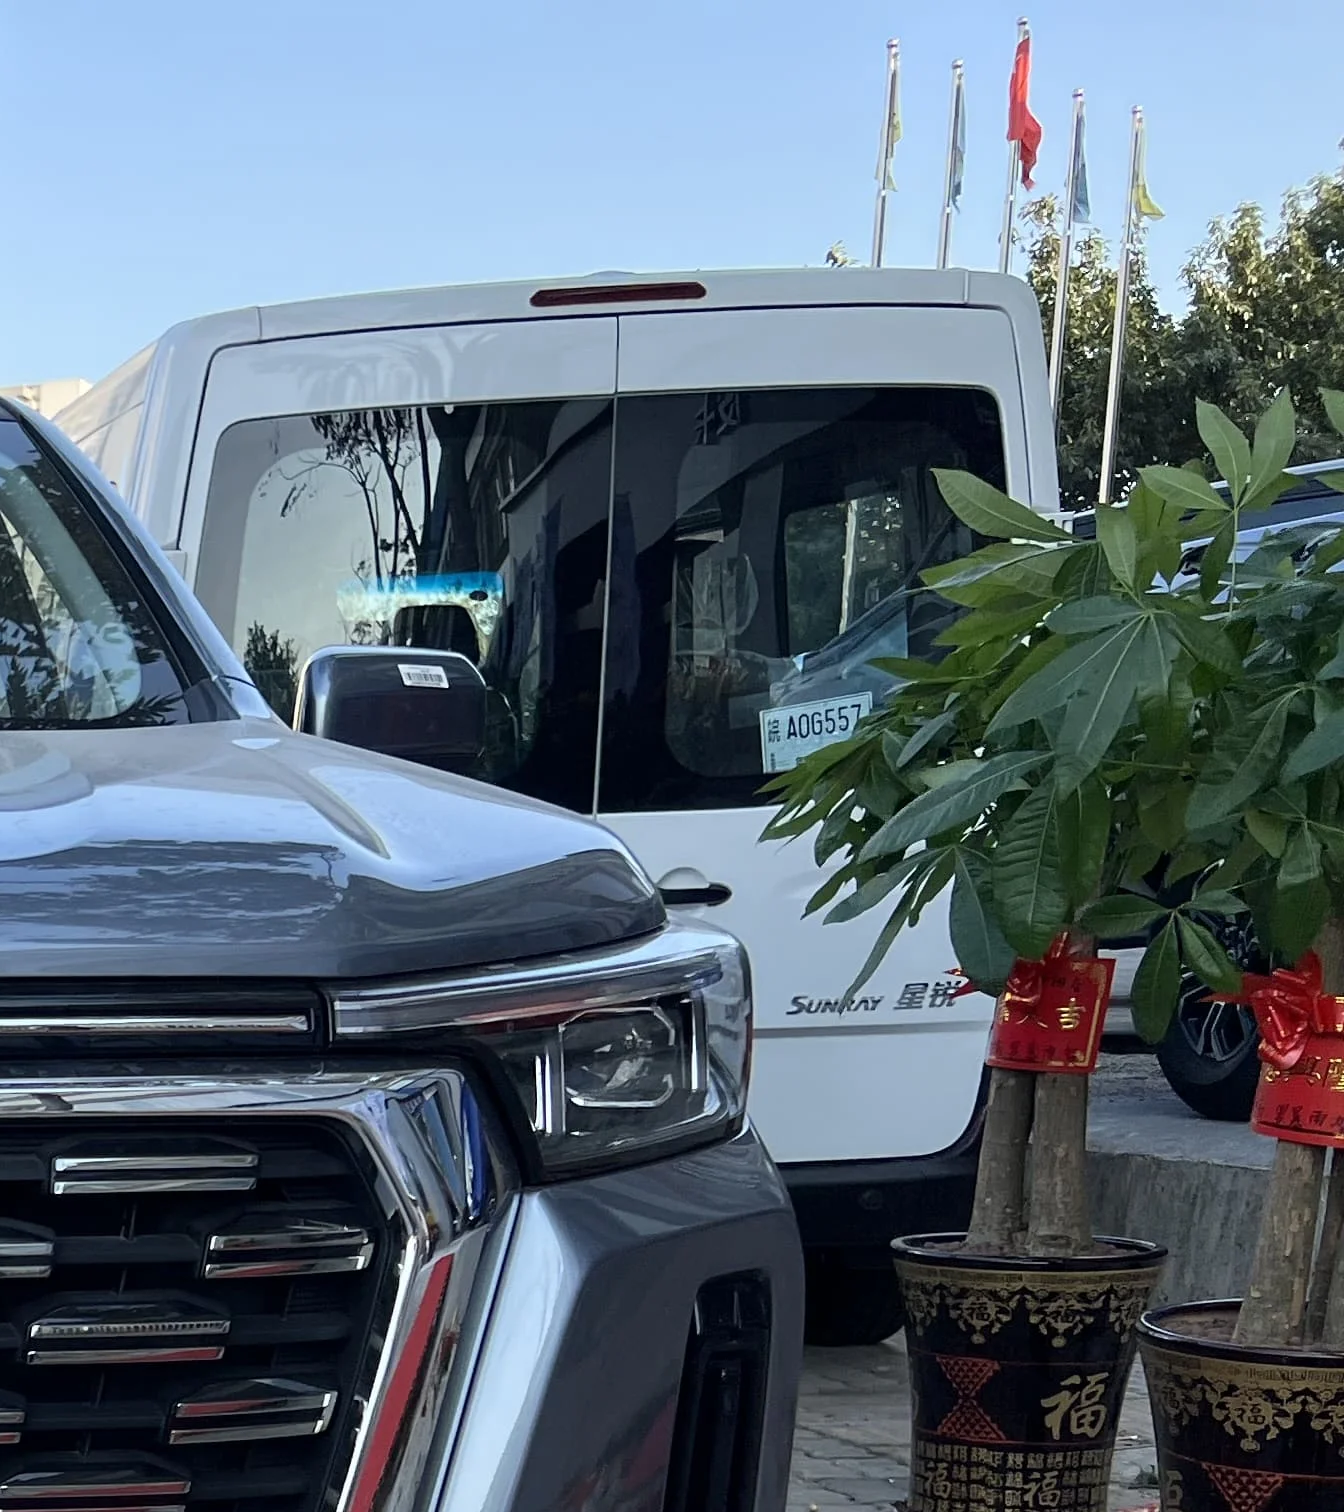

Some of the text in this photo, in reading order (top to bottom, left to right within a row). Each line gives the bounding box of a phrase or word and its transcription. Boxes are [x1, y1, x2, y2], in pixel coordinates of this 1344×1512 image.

[893, 980, 962, 1011] 星锐
[1040, 1371, 1110, 1441] 福
[1023, 1470, 1061, 1508] 福
